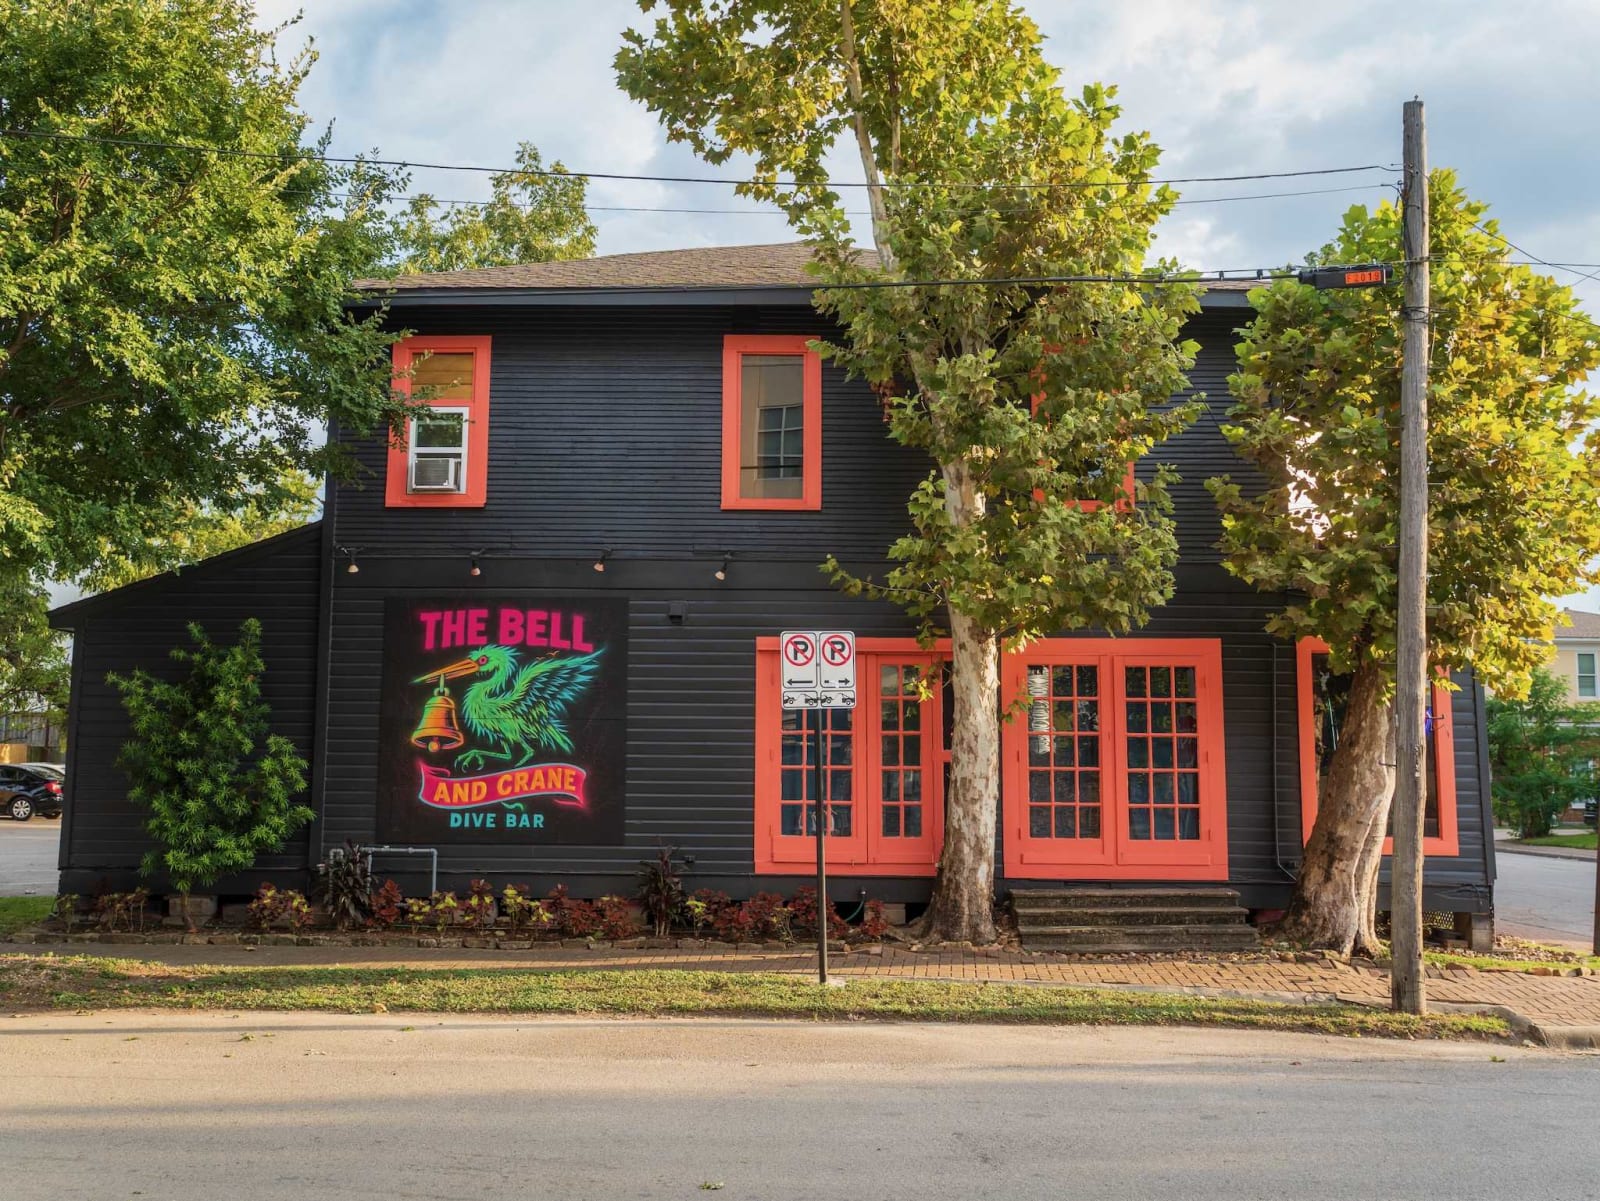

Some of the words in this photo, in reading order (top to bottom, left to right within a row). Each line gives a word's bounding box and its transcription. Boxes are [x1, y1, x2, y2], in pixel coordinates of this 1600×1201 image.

[420, 609, 488, 650] THE
[499, 609, 593, 652] BELL
[793, 640, 809, 661] P
[830, 640, 846, 661] P
[433, 781, 487, 803] AND
[496, 768, 576, 796] CRANE
[450, 813, 497, 828] DIVE
[506, 814, 545, 828] BAR
